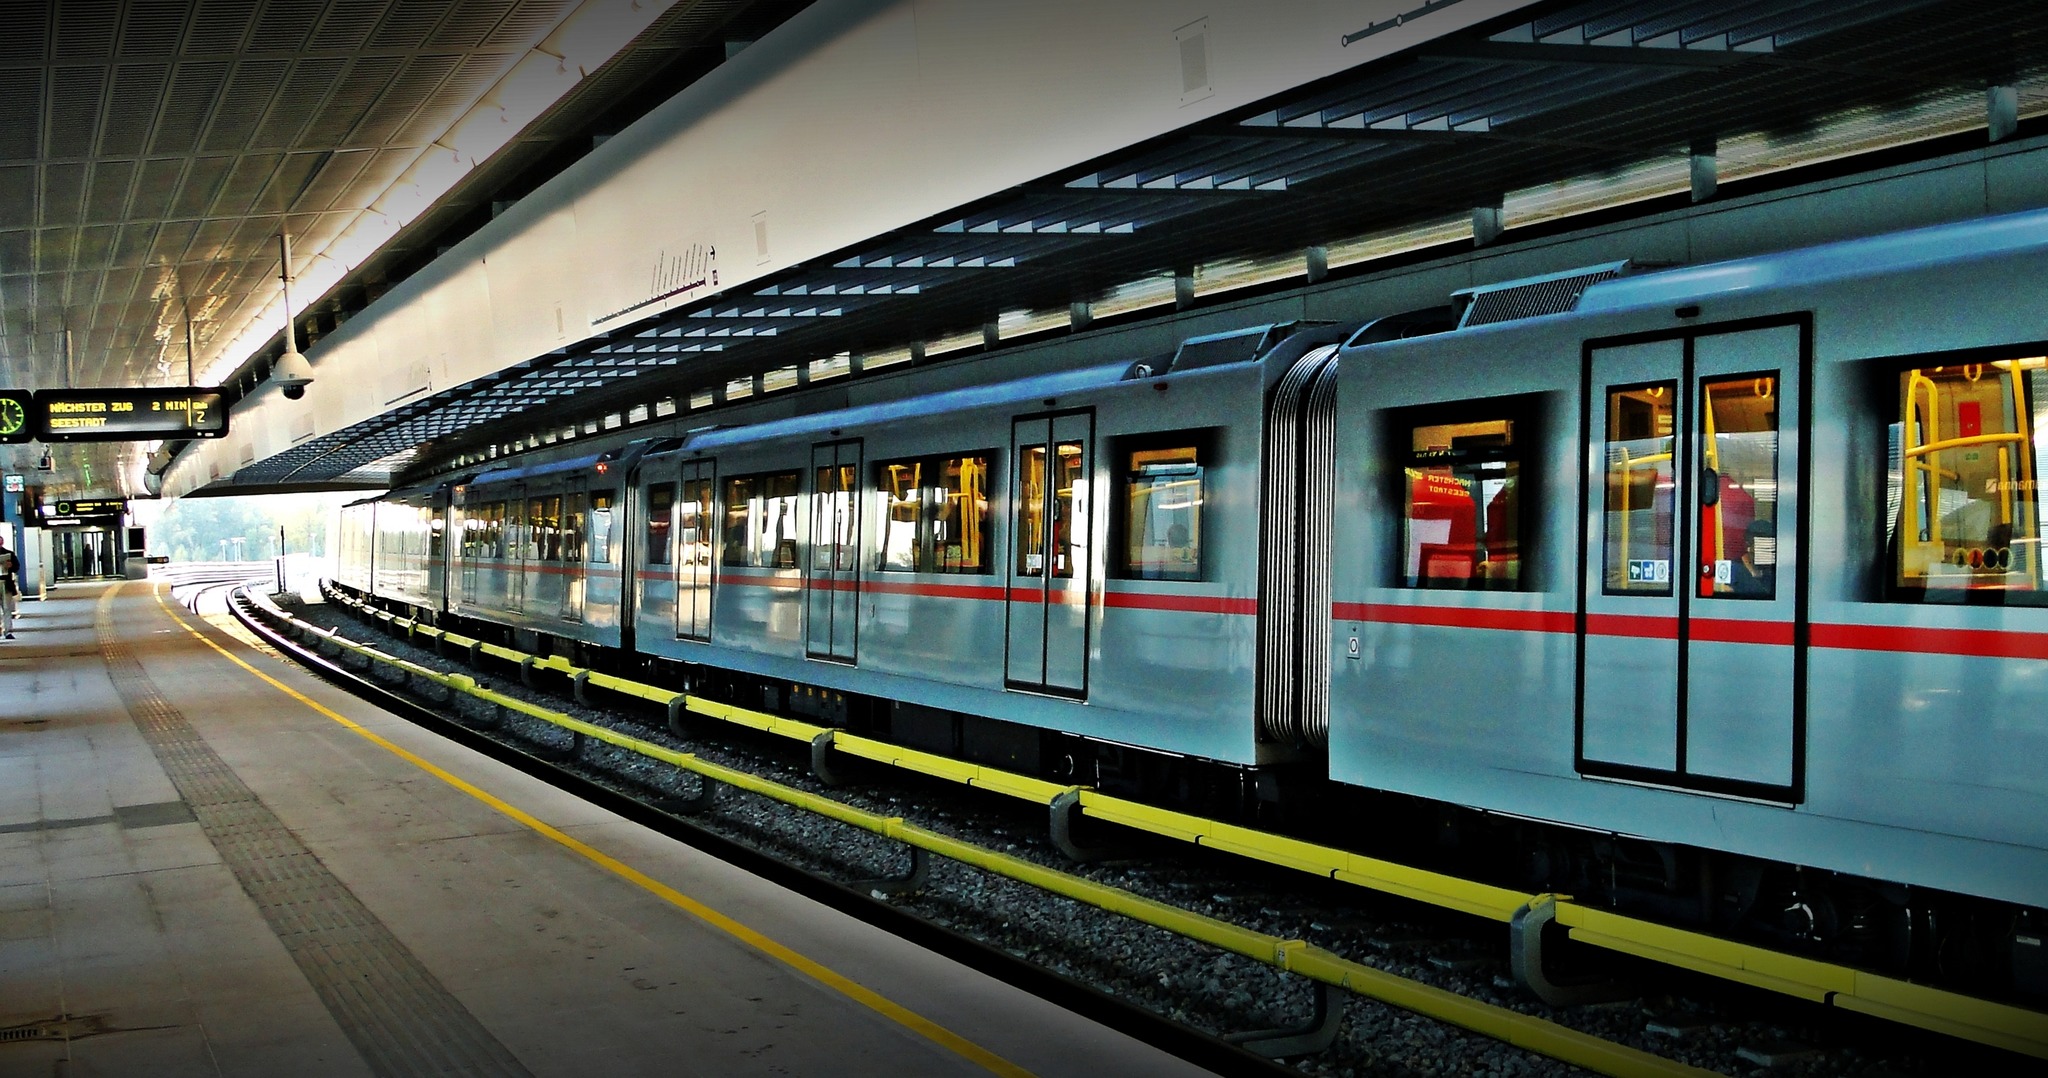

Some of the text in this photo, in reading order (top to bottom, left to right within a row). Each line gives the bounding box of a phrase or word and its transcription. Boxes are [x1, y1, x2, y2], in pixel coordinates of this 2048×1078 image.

[49, 402, 106, 412] NÄCHSTER
[111, 402, 133, 411] ZUG
[152, 401, 160, 410] 2
[165, 401, 187, 410] MIN
[50, 418, 106, 427] SEESTADT
